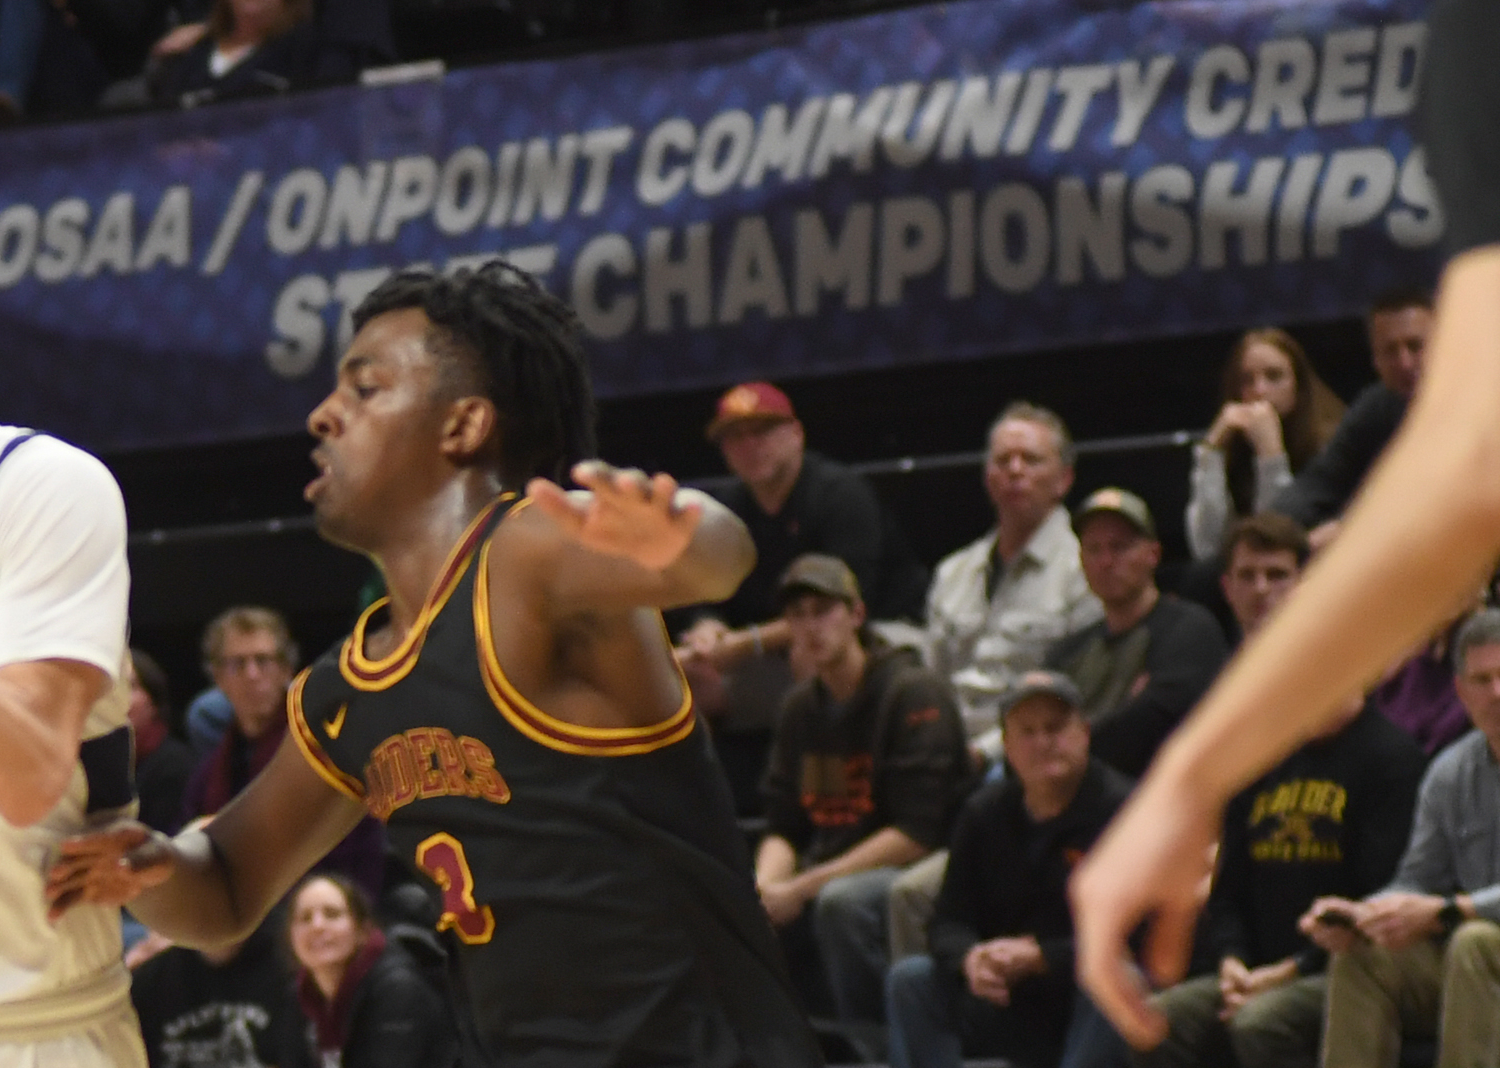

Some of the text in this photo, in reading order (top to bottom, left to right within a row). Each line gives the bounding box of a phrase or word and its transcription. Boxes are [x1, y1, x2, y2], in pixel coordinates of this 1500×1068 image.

[203, 169, 265, 276] /
[268, 124, 634, 256] ONPOINT
[636, 55, 1176, 206] COMMUNITY
[571, 146, 1446, 341] CHAMPIONSHIPS
